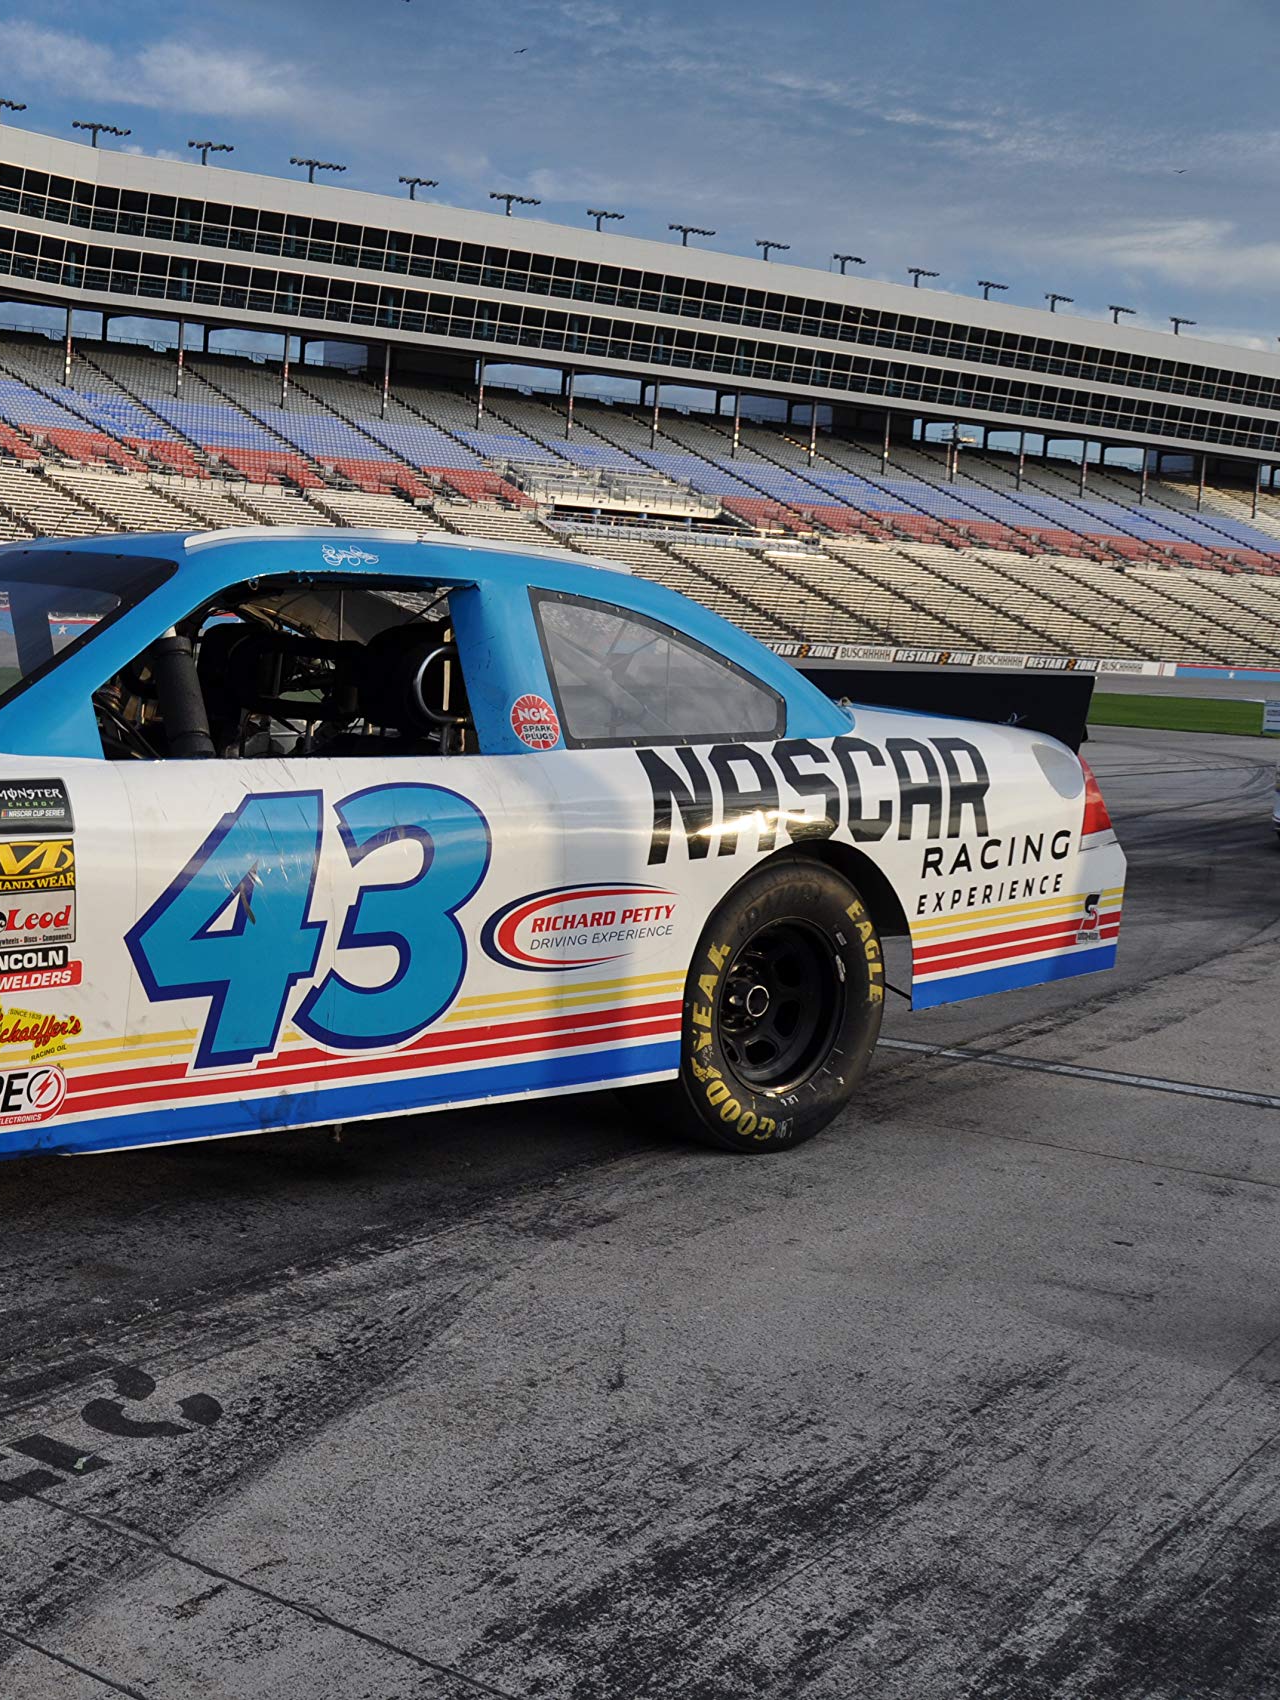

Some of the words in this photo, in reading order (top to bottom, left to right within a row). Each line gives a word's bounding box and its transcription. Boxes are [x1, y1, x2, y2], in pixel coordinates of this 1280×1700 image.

[810, 645, 837, 658] ZONE
[895, 649, 940, 663] RESTART
[948, 653, 974, 665] ZONE
[1026, 657, 1068, 670] RESTART
[517, 707, 550, 722] NGK
[523, 725, 552, 733] SPARK
[525, 732, 554, 740] PLUGS
[636, 736, 991, 866] NASCAR
[8, 809, 32, 817] NASCAR
[32, 809, 45, 817] CUP
[45, 808, 65, 816] SERIES
[920, 829, 1072, 879] RACING
[35, 872, 75, 888] WEAR
[917, 873, 1063, 915] EXPERIENCE
[123, 782, 492, 1070] 43
[531, 910, 616, 933] RICHARD
[620, 904, 676, 924] PETTY
[530, 933, 587, 950] DRIVING
[592, 925, 674, 944] EXPERIENCE
[845, 899, 885, 1005] EAGLE
[30, 1047, 55, 1062] RACING
[56, 1044, 67, 1052] OIL
